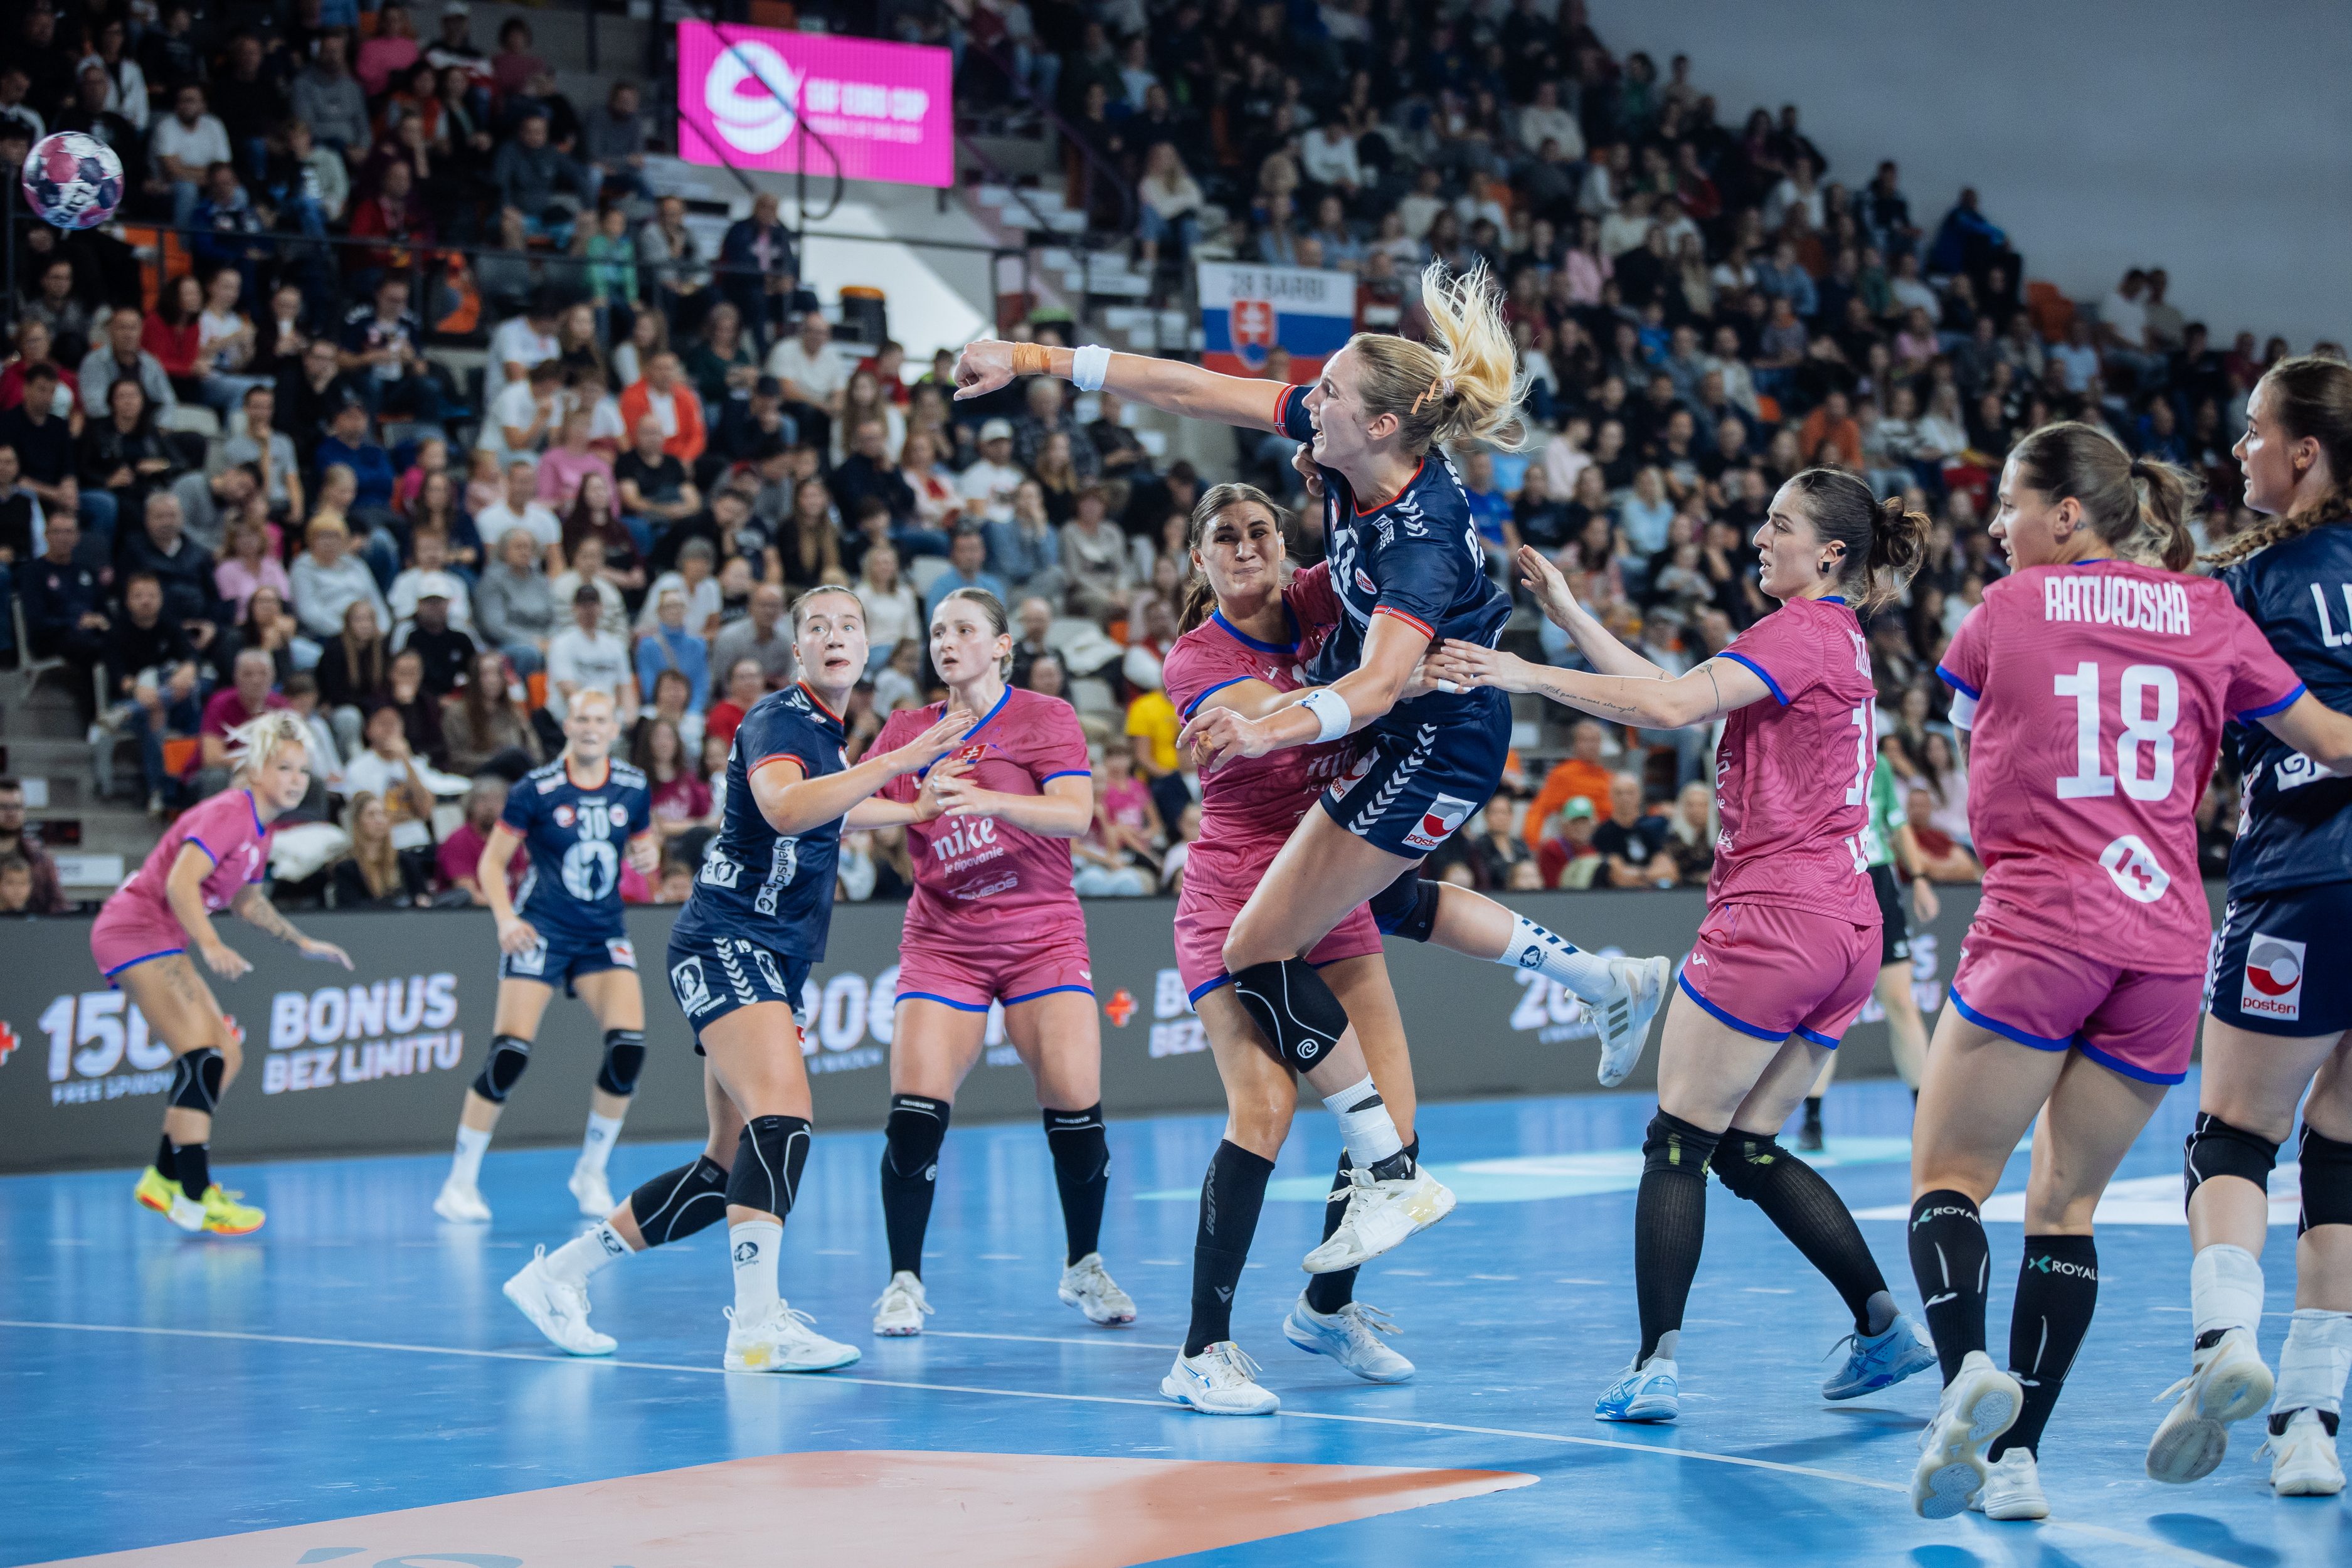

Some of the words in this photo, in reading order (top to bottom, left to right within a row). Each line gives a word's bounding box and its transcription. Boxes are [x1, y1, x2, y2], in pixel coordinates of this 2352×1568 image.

[2310, 583, 2352, 647] L.
[1603, 702, 1637, 712] strength
[2054, 662, 2179, 801] 18
[1845, 697, 1878, 806] 1
[577, 807, 610, 841] 30
[931, 816, 997, 861] nike
[1405, 834, 1441, 847] poste
[944, 862, 953, 878] je
[953, 846, 1004, 872] tipovanie
[734, 939, 752, 953] 19
[268, 972, 458, 1050] BONUS
[700, 993, 727, 1014] hummel
[2242, 997, 2296, 1014] posten
[262, 1044, 337, 1095] BEZ
[339, 1030, 464, 1082] LIMITU
[2052, 1259, 2098, 1281] ROYAL
